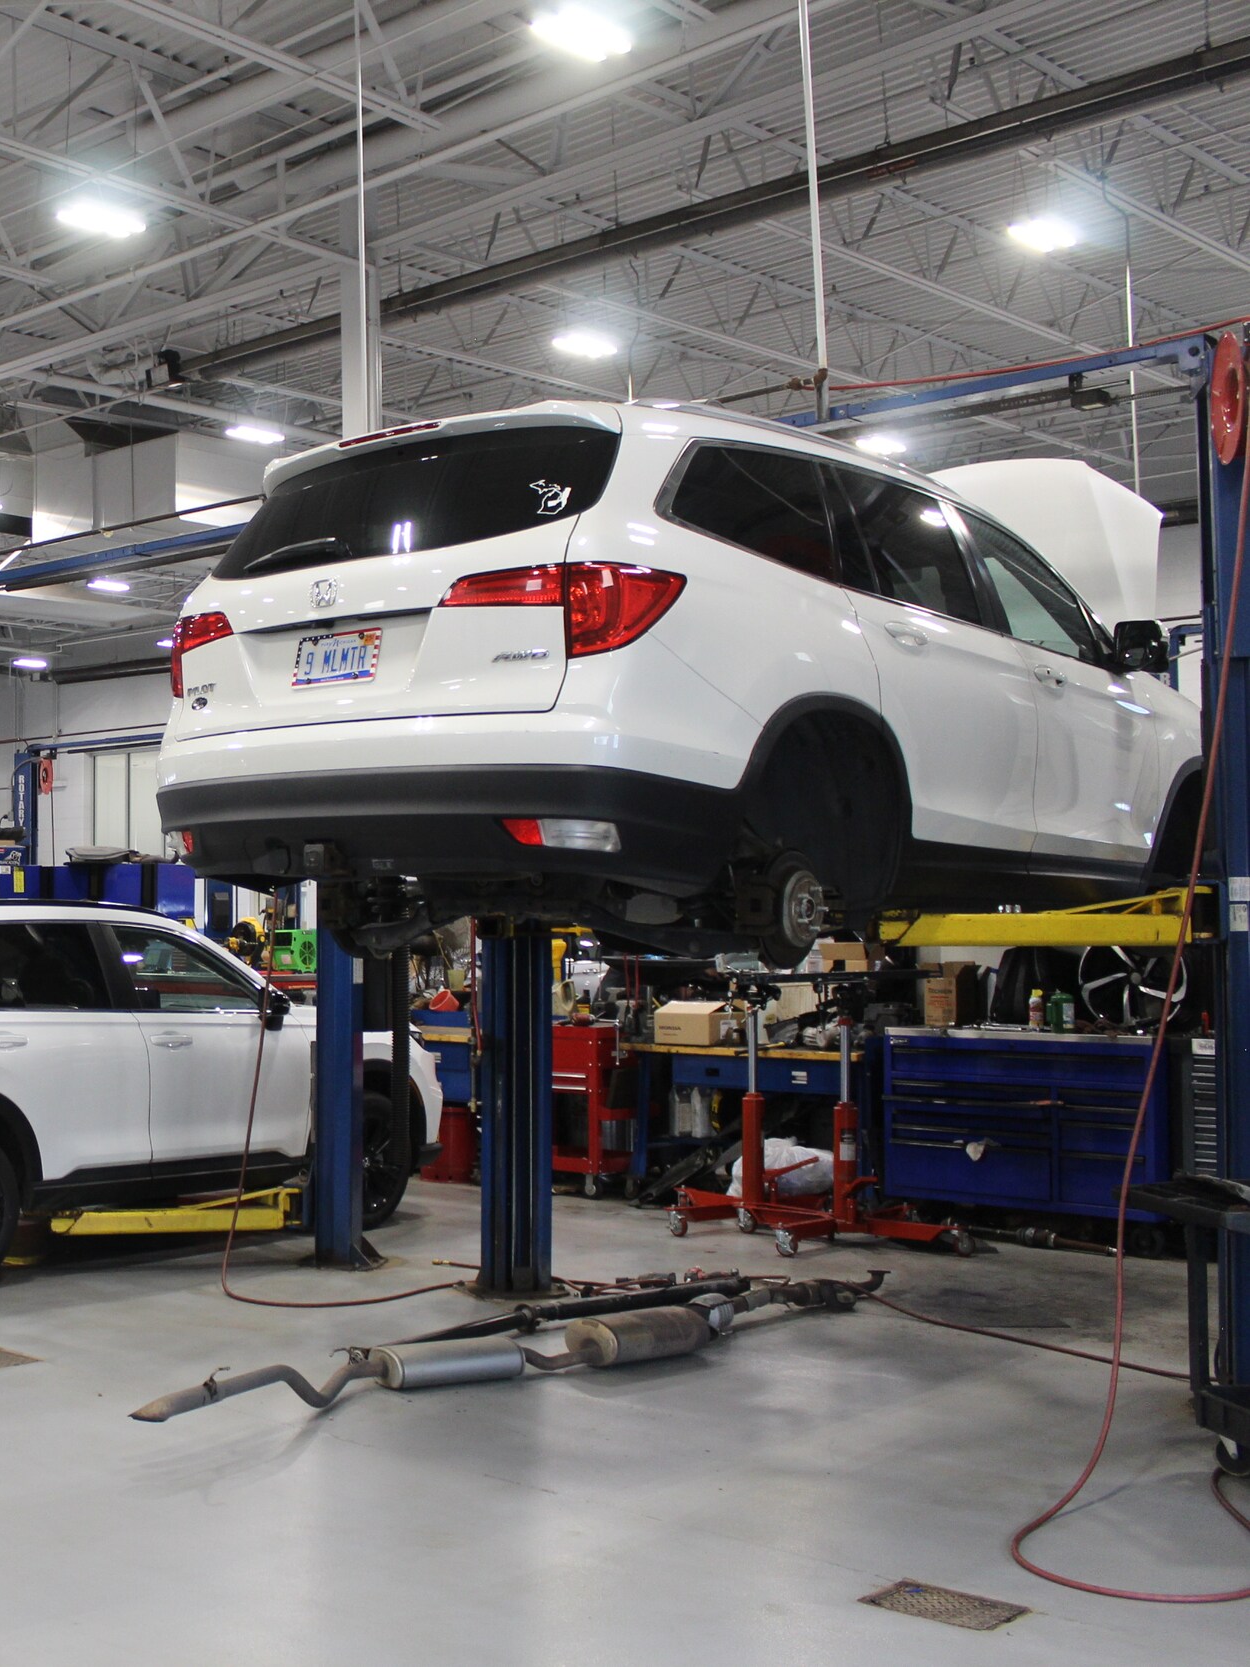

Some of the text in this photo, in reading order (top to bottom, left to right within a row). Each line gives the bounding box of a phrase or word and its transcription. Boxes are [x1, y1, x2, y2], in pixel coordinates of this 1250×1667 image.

[304, 645, 367, 675] 9 MLMTR
[187, 683, 216, 697] PILOT
